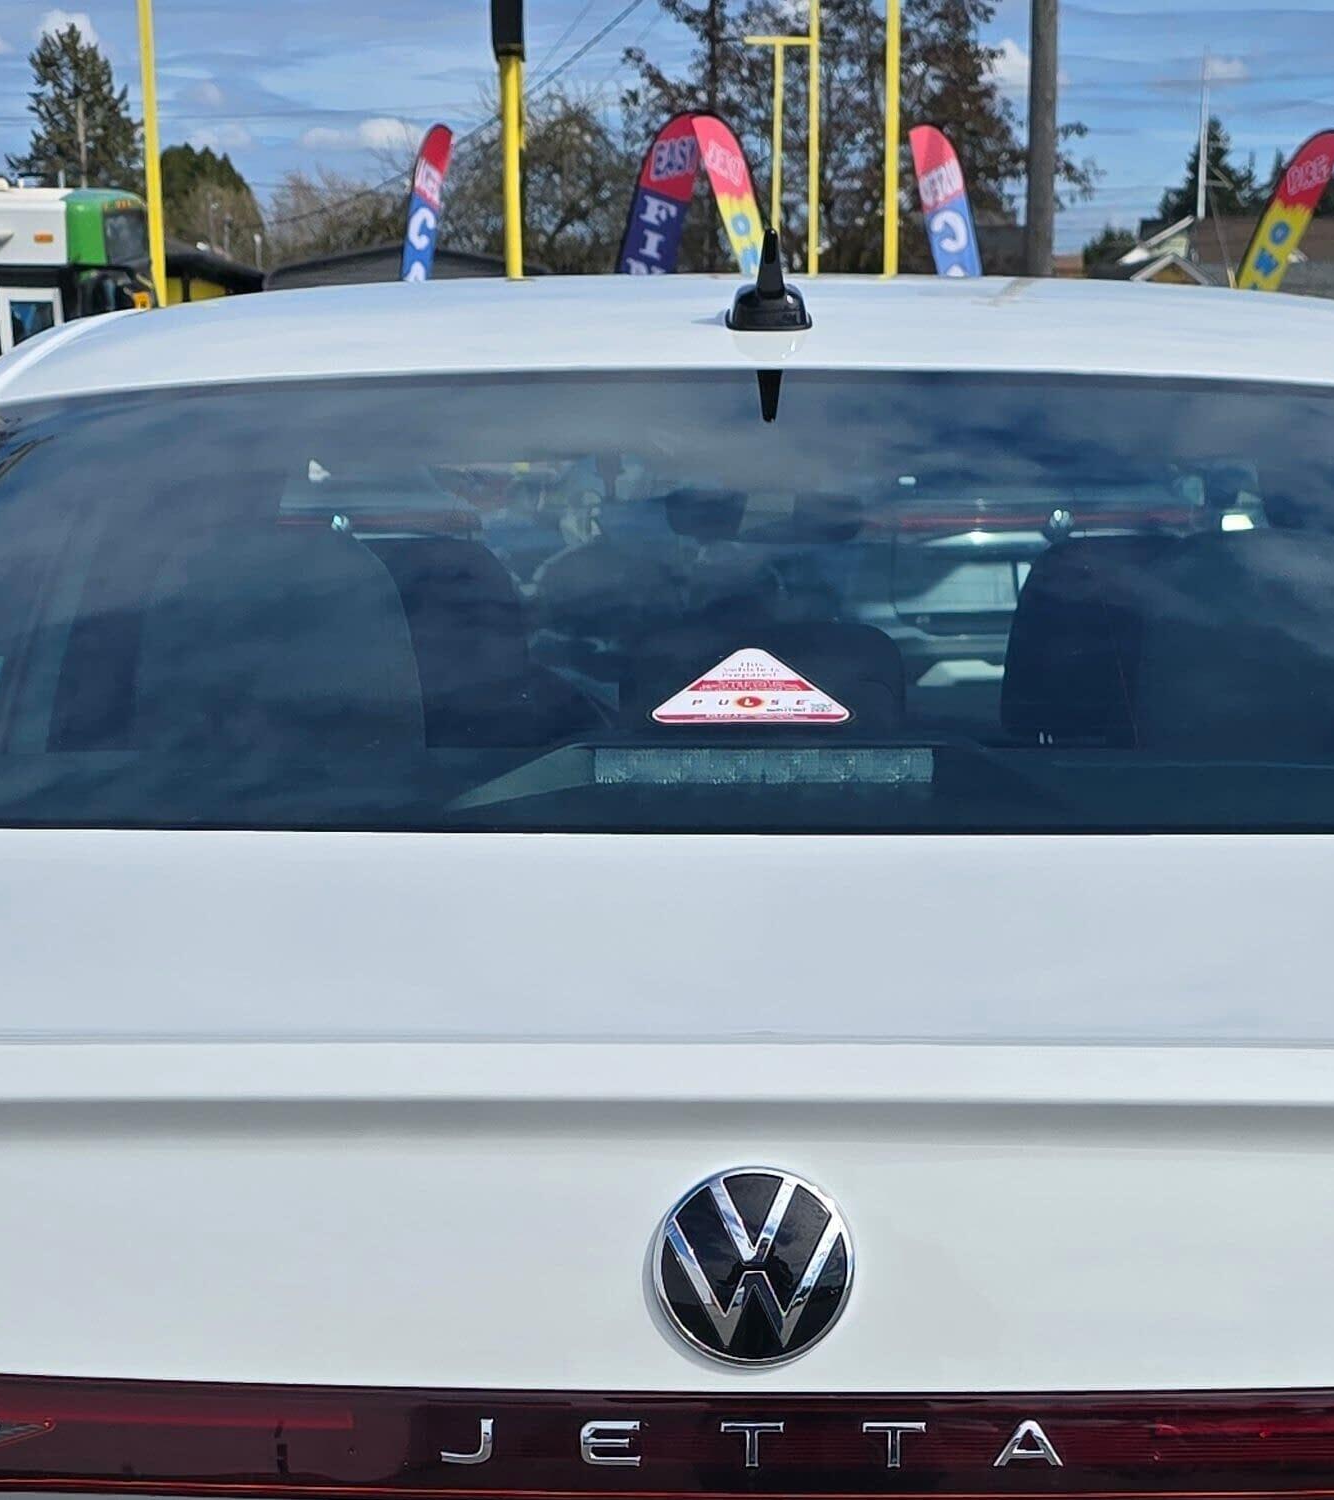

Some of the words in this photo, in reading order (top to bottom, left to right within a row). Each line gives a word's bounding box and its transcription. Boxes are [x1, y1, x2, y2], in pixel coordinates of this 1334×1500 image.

[650, 136, 698, 182] EASY
[691, 696, 806, 708] PULSE
[440, 1418, 1064, 1468] JETTA
